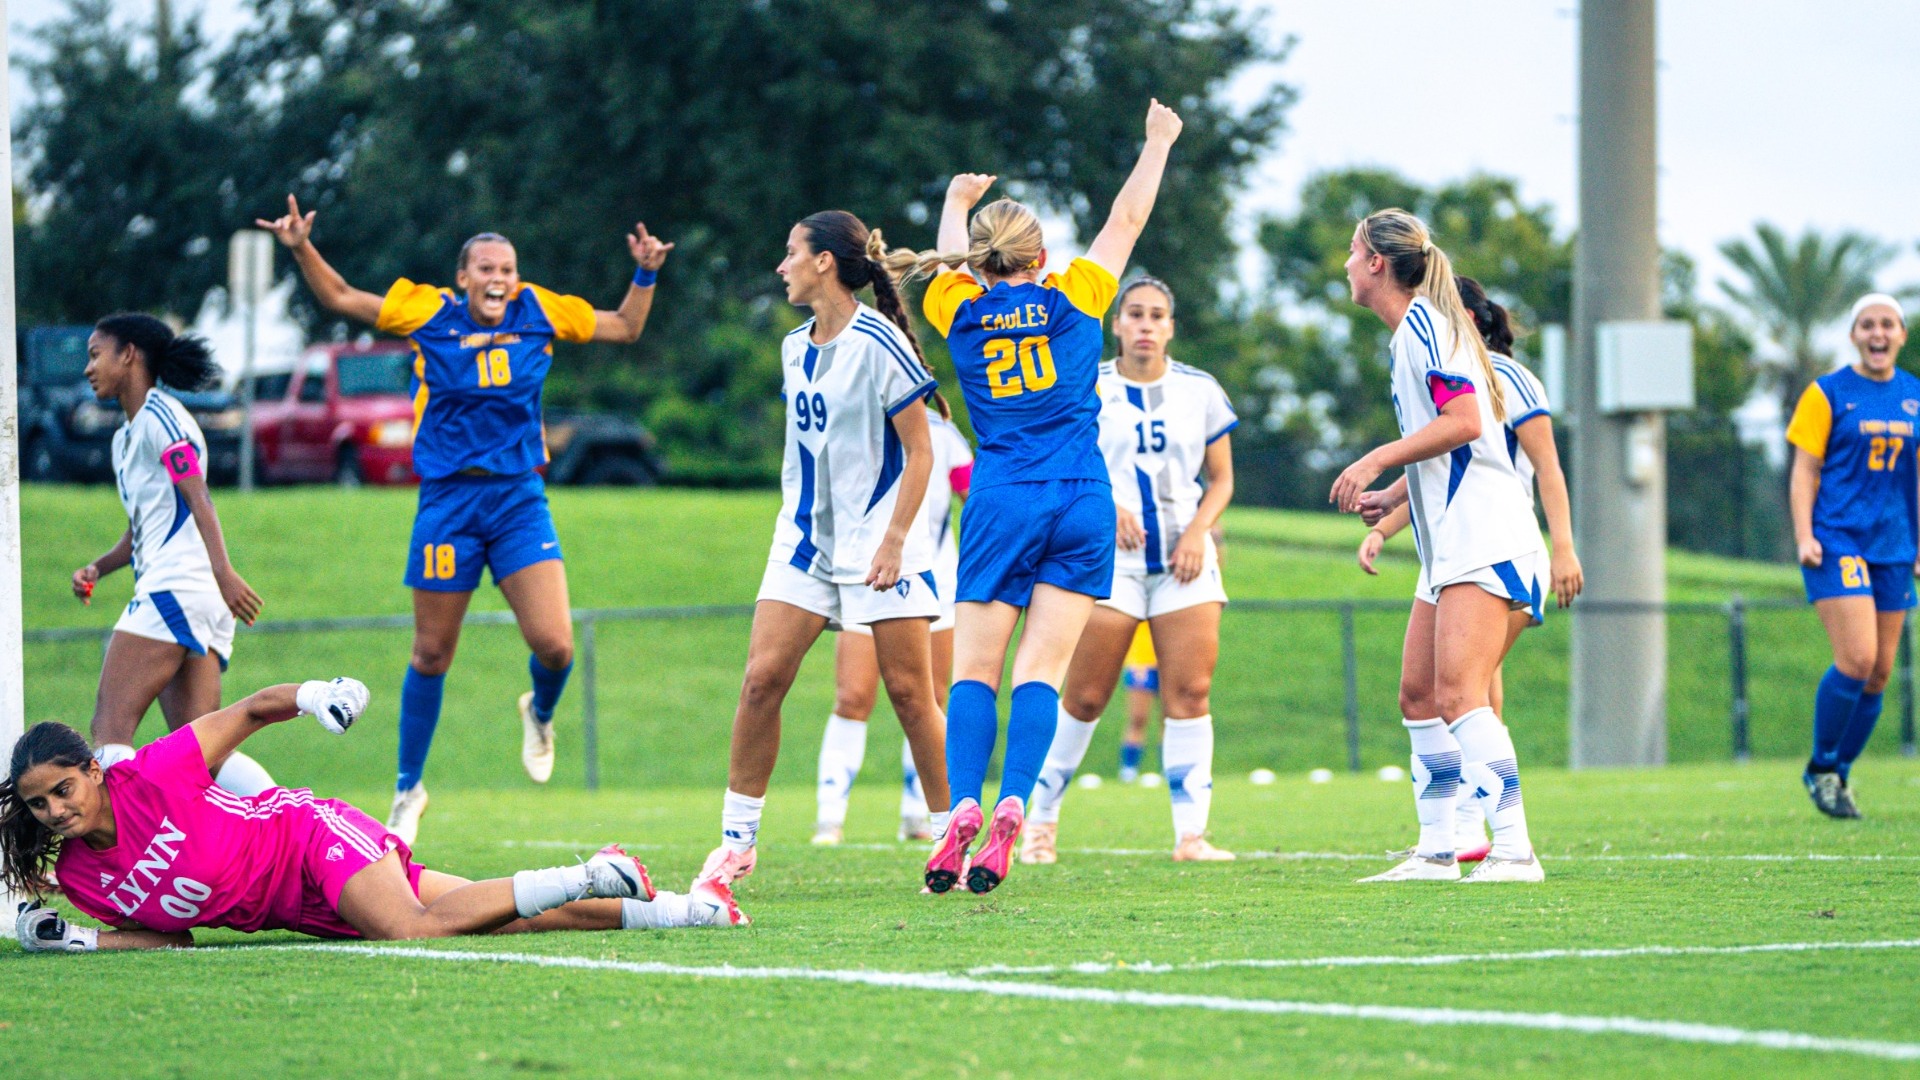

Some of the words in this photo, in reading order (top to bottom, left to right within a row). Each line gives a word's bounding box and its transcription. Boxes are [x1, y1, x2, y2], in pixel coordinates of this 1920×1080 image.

[475, 348, 512, 388] 18
[983, 334, 1058, 399] 20
[795, 390, 828, 433] 99
[1135, 420, 1167, 454] 15
[1867, 436, 1904, 472] 27
[170, 451, 190, 475] C
[423, 543, 456, 580] 18
[106, 815, 187, 917] LYNN
[160, 876, 213, 919] 00
